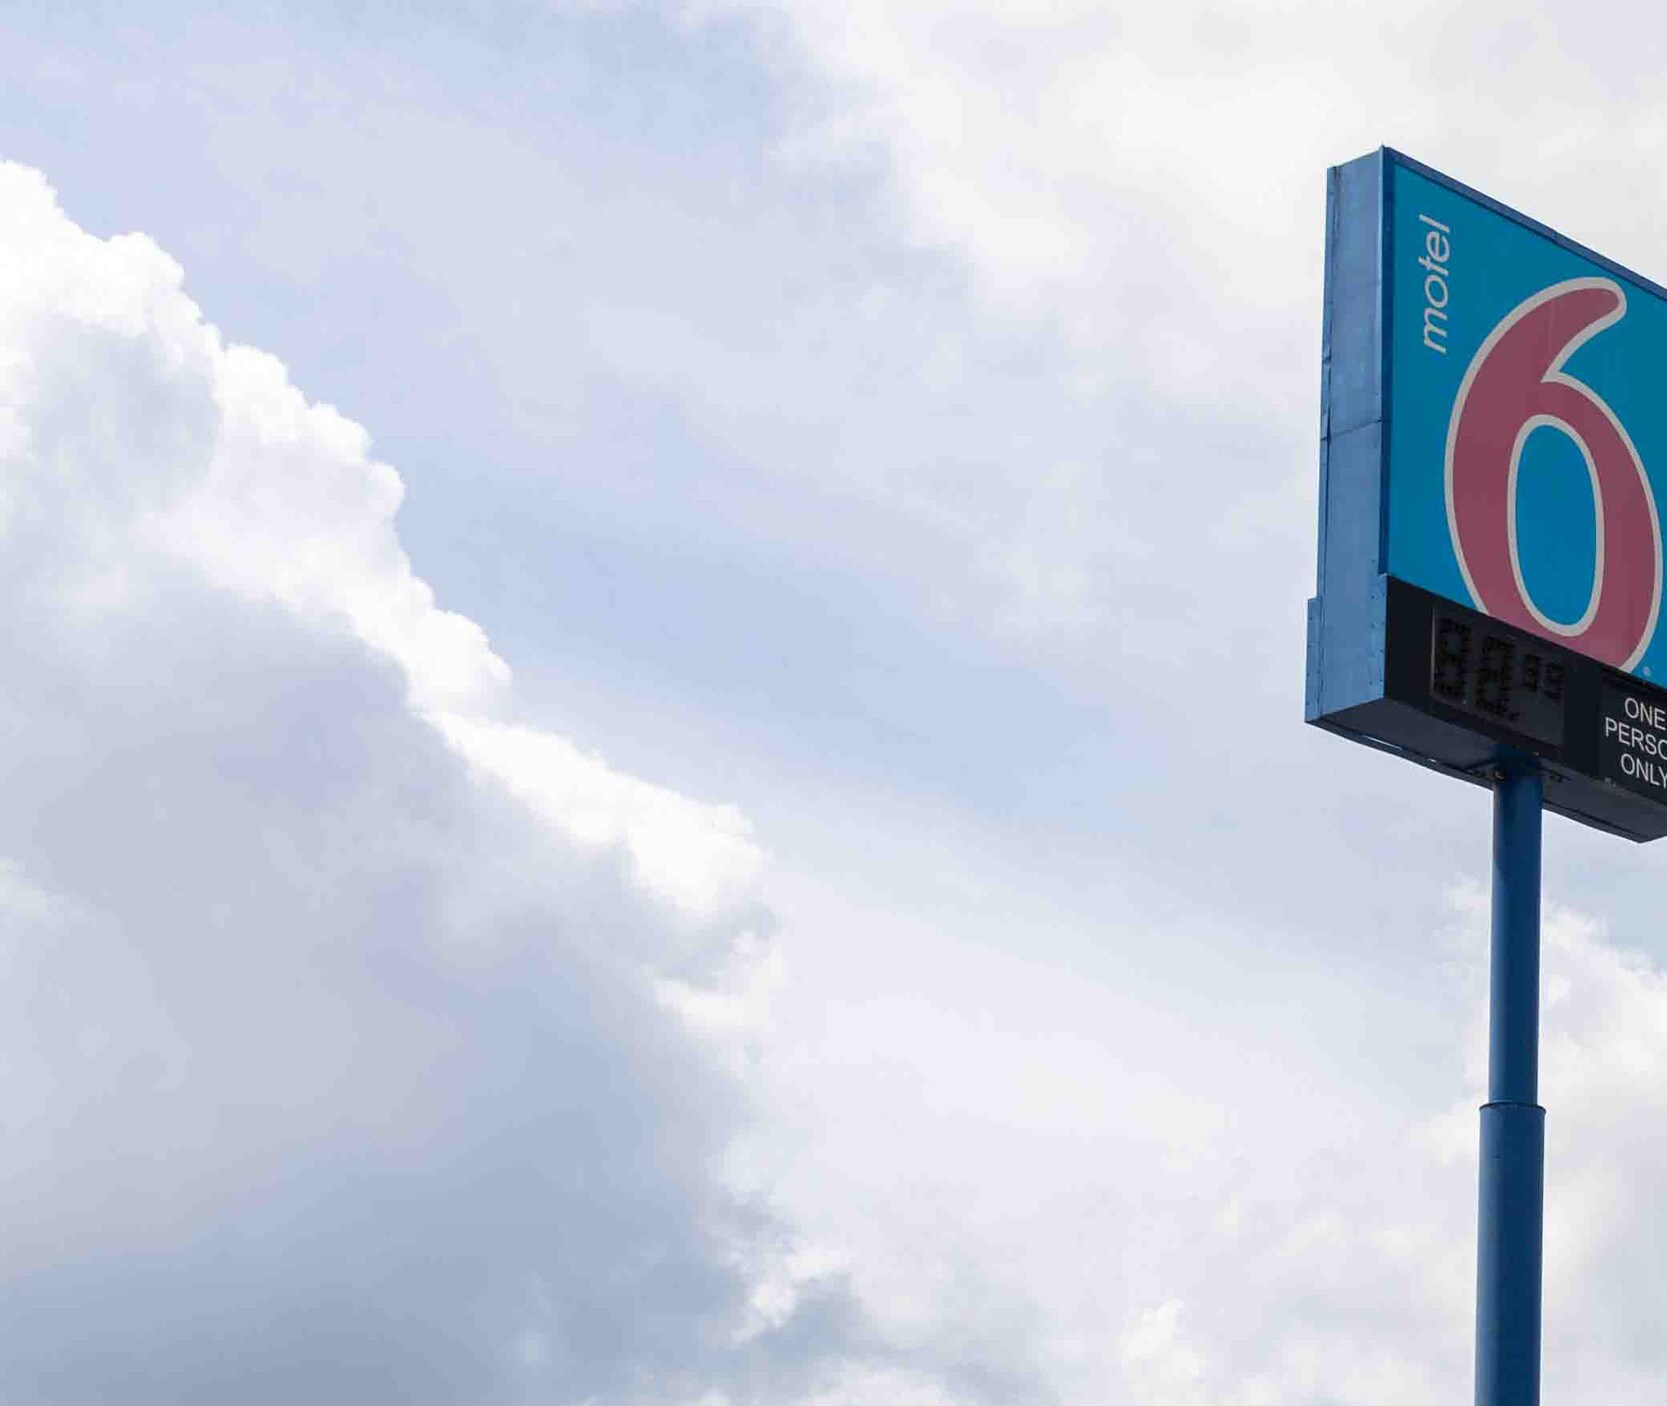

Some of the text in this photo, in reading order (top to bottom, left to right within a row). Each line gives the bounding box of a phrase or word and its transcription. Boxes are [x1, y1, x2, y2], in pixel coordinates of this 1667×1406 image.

[1417, 213, 1451, 354] motel
[1444, 276, 1664, 675] 6
[1624, 696, 1667, 731] ONE
